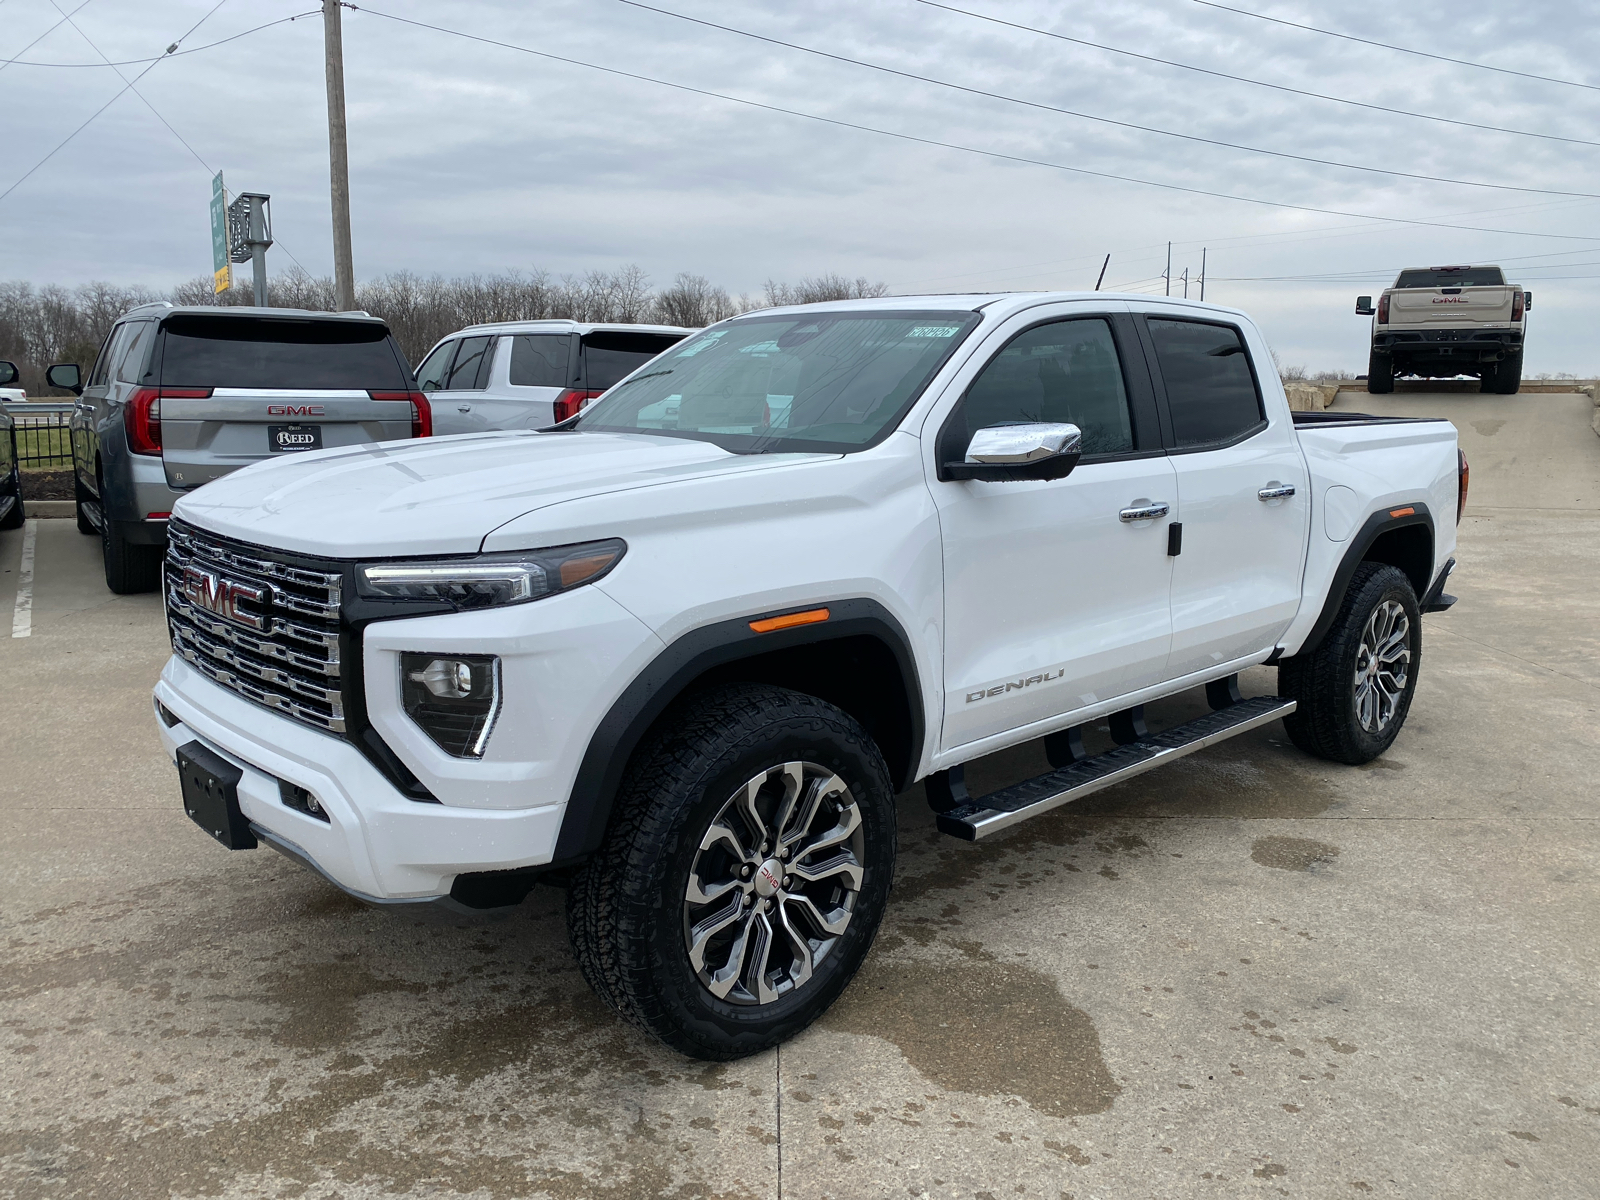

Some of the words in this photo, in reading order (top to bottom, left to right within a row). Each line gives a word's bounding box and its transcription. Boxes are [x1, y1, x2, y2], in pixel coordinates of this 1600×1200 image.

[1432, 296, 1469, 304] GMC
[267, 405, 325, 416] GMC
[276, 431, 314, 446] REED
[183, 564, 264, 630] GMC
[966, 667, 1065, 703] DENALI
[761, 867, 779, 889] GMC
